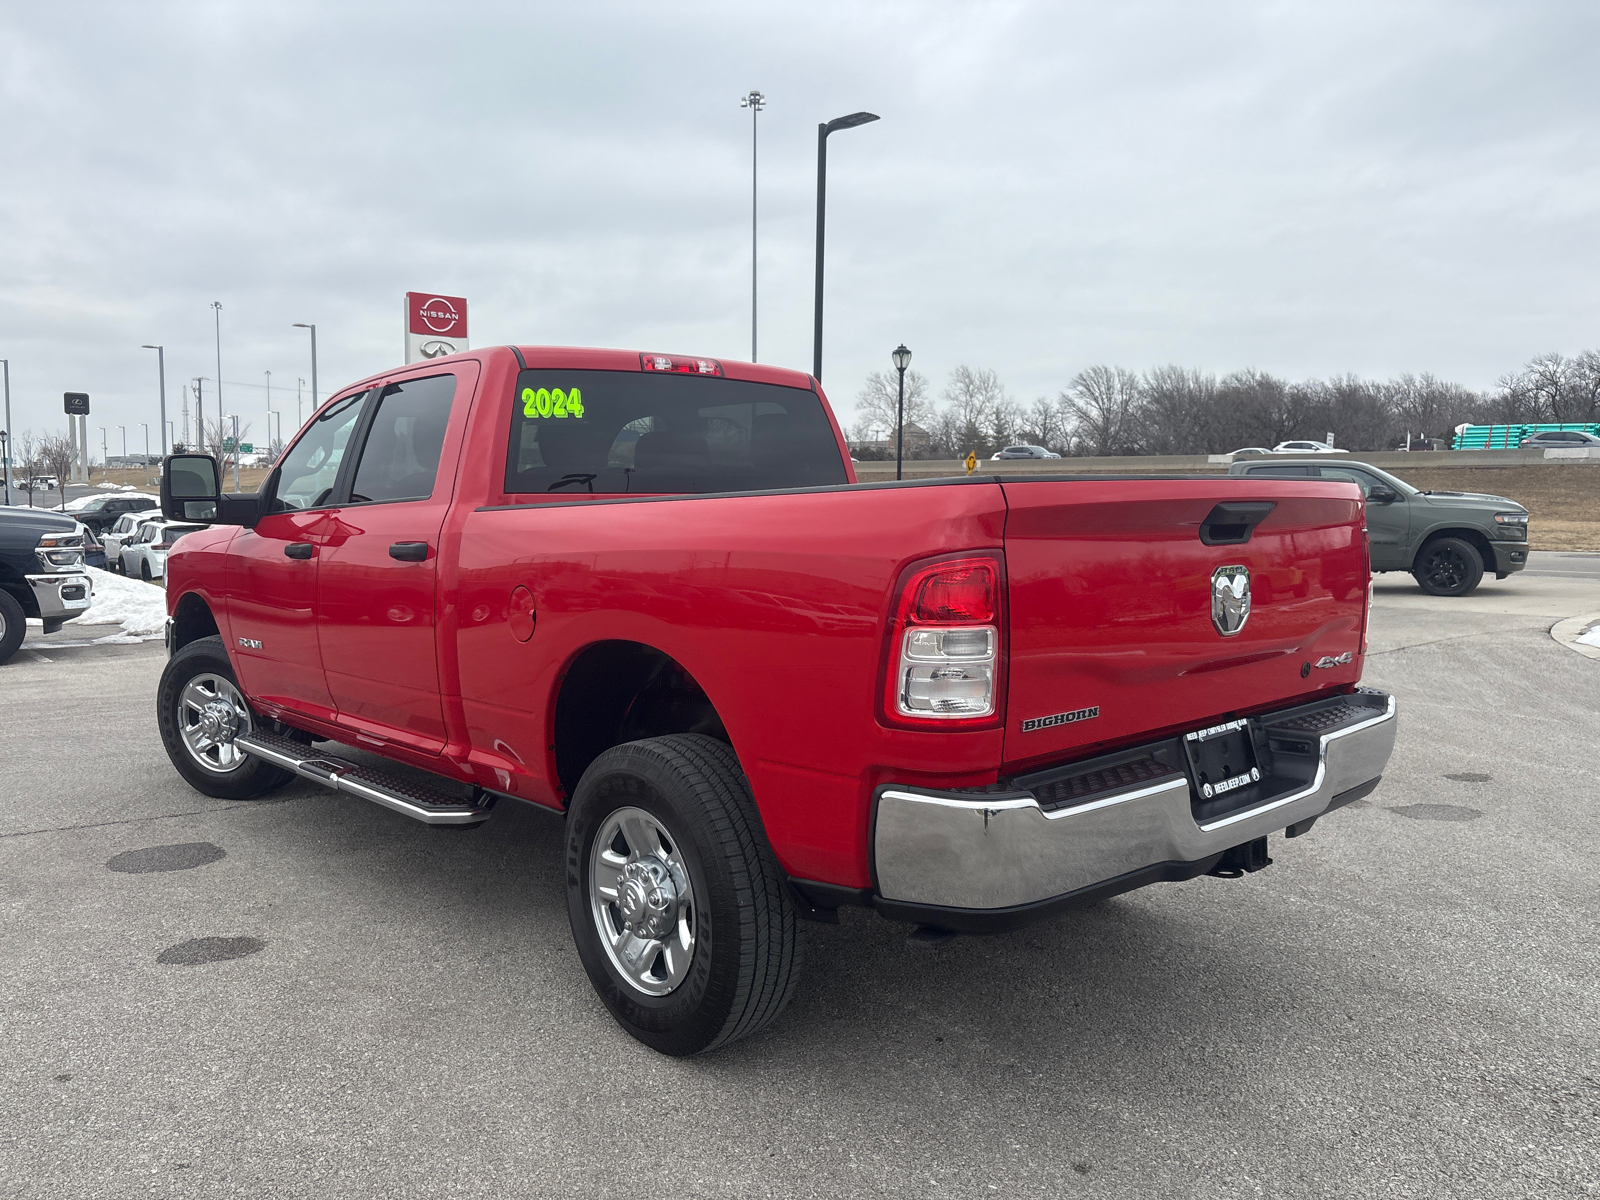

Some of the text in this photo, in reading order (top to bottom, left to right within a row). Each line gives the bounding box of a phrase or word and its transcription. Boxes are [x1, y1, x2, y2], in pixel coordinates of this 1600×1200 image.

[419, 310, 459, 320] NISSAN
[521, 387, 585, 419] 2024
[238, 637, 263, 650] RAM
[1023, 705, 1100, 732] BIGHORN
[1214, 774, 1251, 794] REEDJEEP.COM
